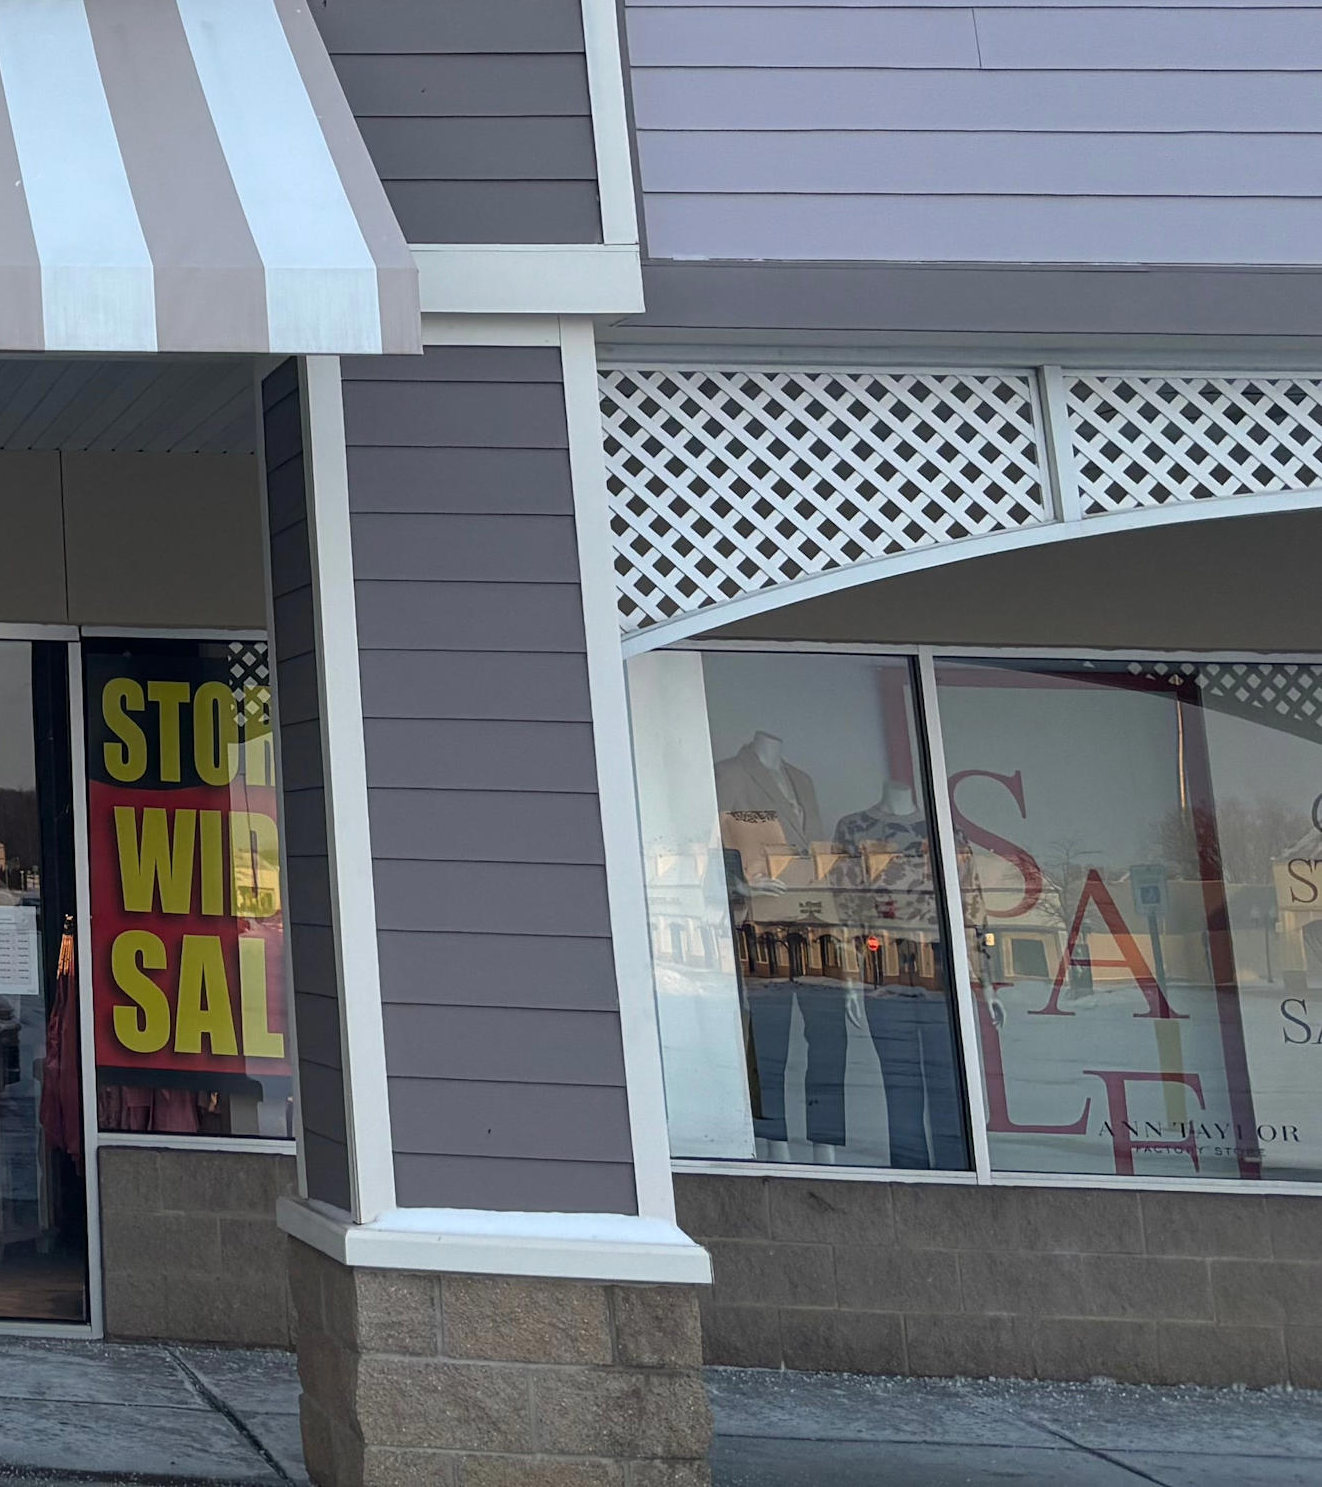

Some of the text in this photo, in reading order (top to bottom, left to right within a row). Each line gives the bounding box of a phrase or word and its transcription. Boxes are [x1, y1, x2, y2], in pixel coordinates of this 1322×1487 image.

[101, 677, 275, 786] STOR
[114, 806, 280, 917] WID
[112, 929, 285, 1058] SAL
[1098, 1120, 1301, 1142] ANN TAYLOR
